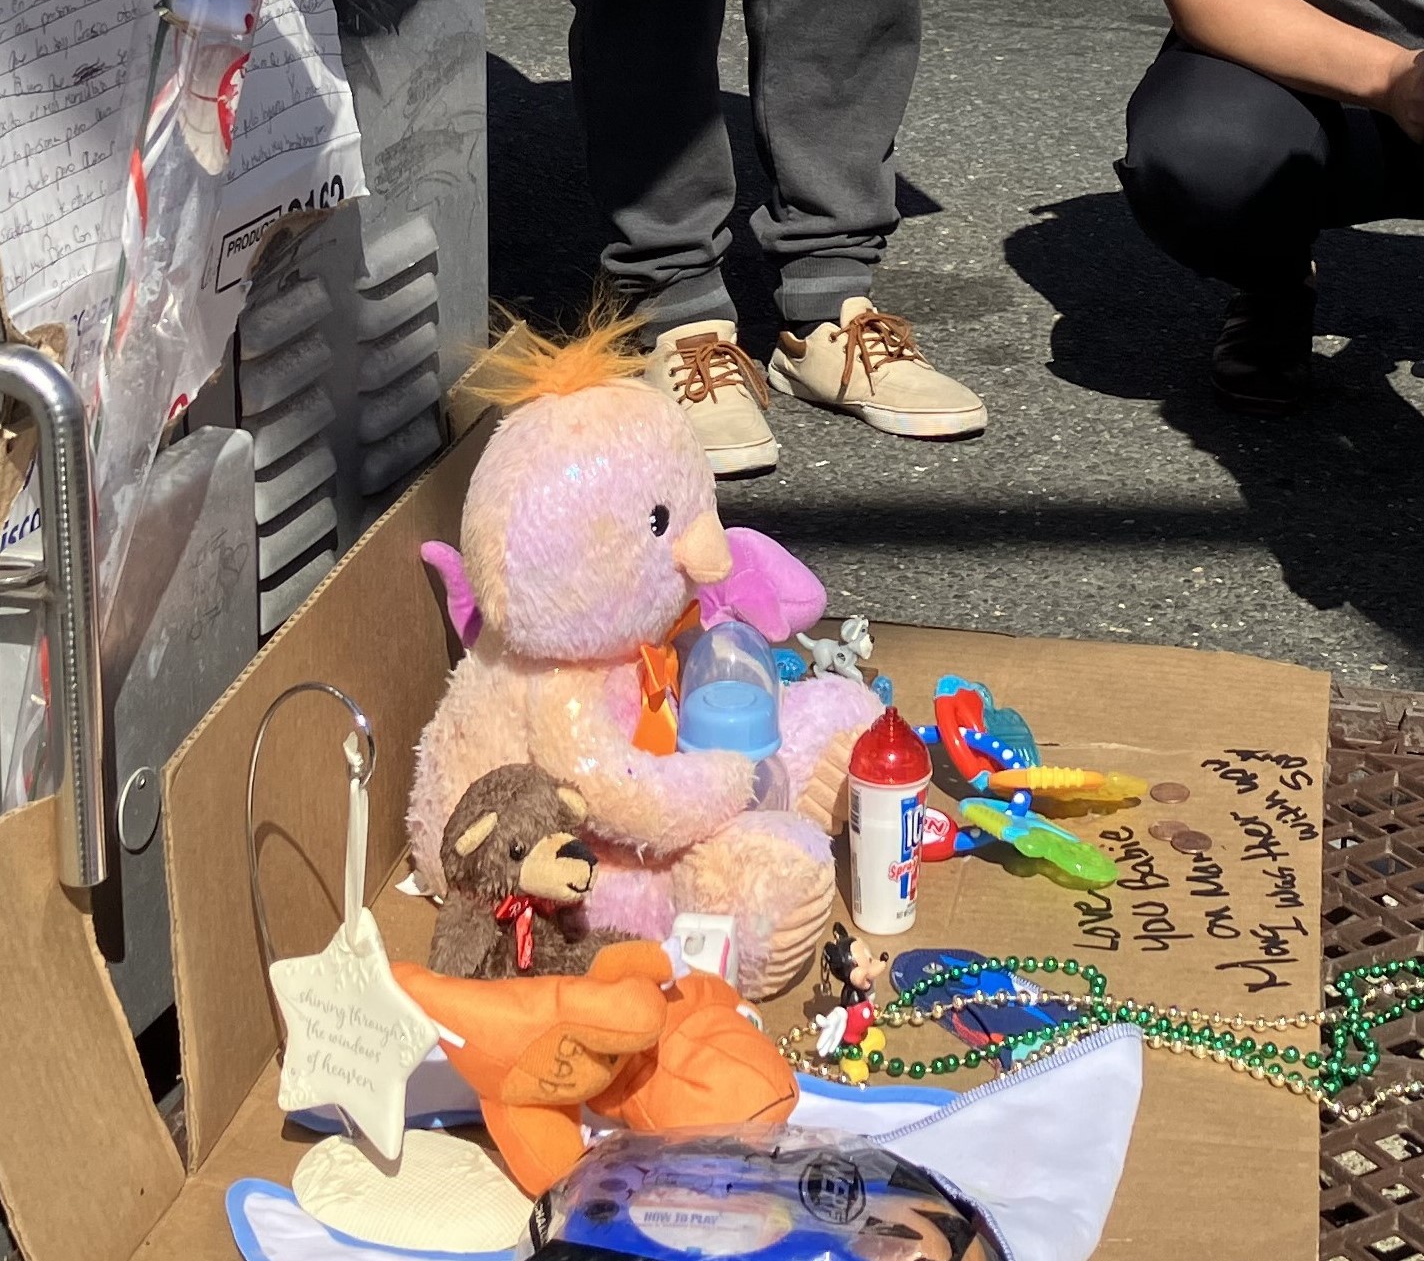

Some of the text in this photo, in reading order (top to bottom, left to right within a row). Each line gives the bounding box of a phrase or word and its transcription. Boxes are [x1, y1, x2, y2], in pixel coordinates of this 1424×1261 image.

[226, 218, 277, 258] PRODUC
[300, 988, 400, 1047] shining through
[306, 1018, 381, 1064] the windows
[306, 1050, 376, 1093] of heaven
